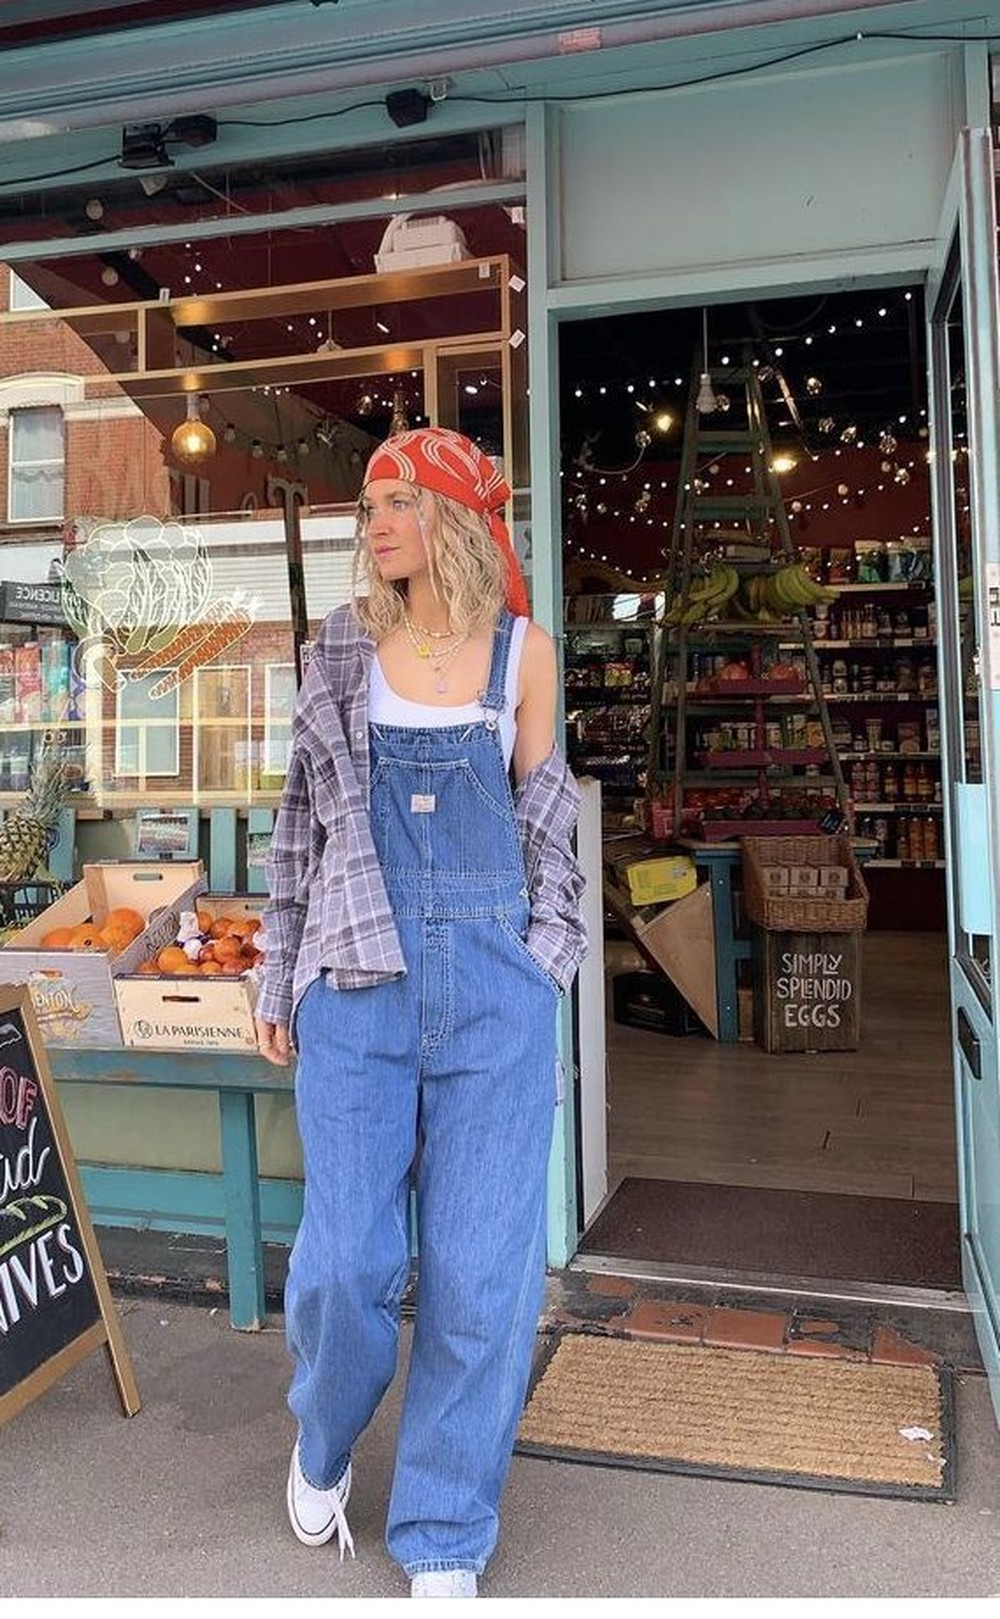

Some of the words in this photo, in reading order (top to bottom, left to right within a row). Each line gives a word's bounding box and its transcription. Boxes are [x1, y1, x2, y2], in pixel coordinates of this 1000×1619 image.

[781, 953, 843, 975] SIMPLY
[31, 989, 80, 1013] ENTON
[776, 977, 851, 1001] SPLENDID
[784, 1004, 841, 1028] EGGS
[155, 1025, 171, 1036] LA
[171, 1026, 244, 1039] PARISIENNE
[0, 1066, 38, 1130] OF
